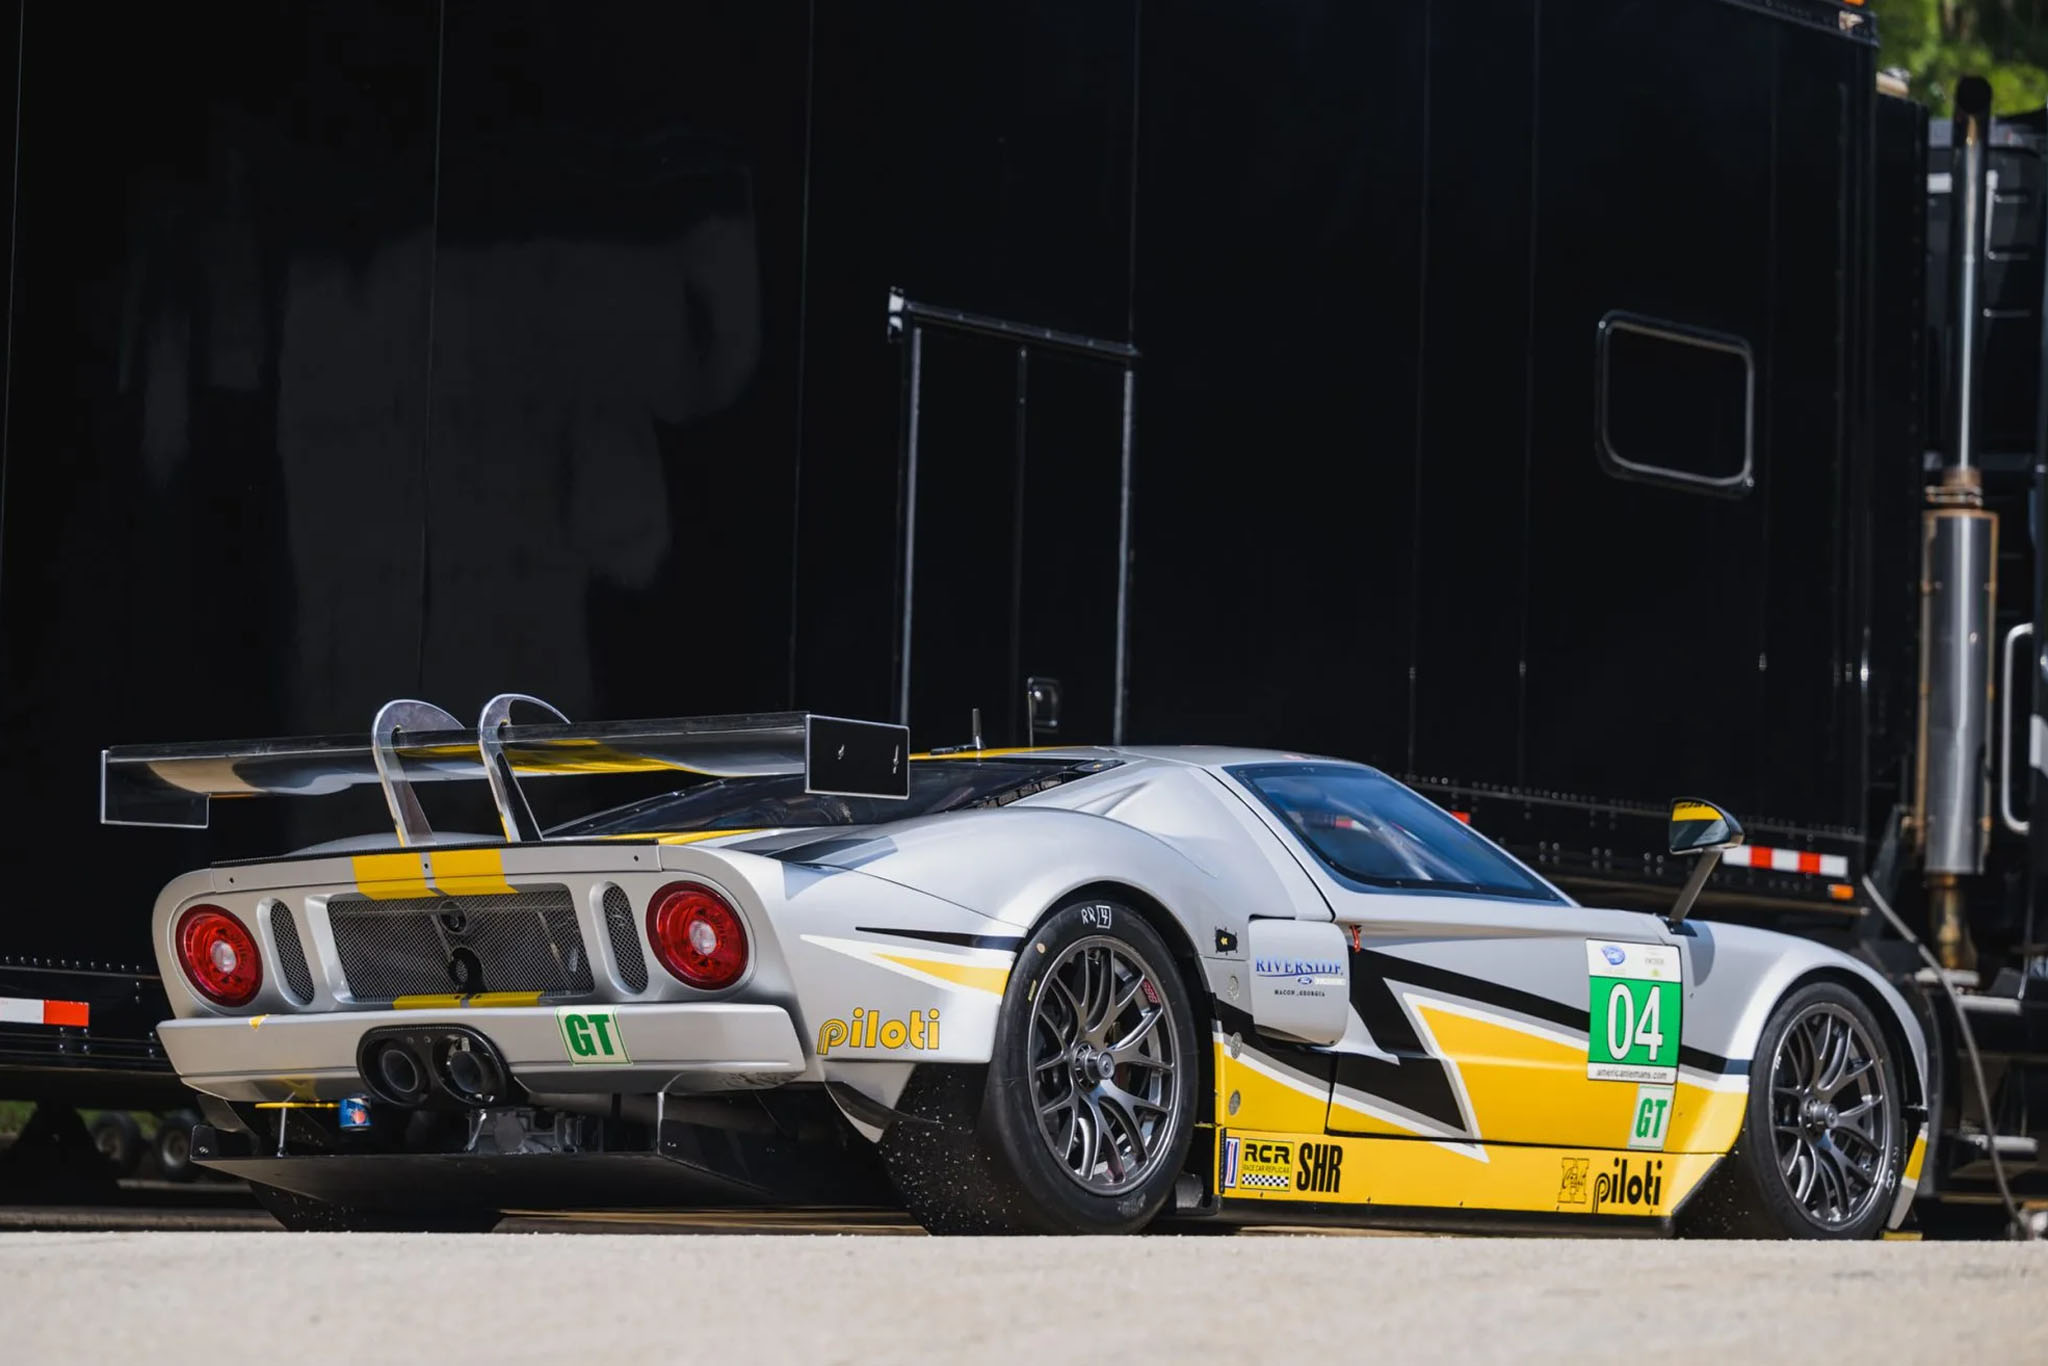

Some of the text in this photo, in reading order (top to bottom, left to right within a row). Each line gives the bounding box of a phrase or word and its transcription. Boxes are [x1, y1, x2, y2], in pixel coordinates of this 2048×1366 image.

[1256, 956, 1341, 975] RIVERSIDE
[564, 1013, 615, 1057] GT
[816, 1007, 940, 1055] piloti
[1607, 982, 1664, 1062] 04
[1597, 1069, 1668, 1080] americanlemans.com
[1635, 1098, 1668, 1138] GT
[1244, 1143, 1290, 1165] RCR
[1296, 1142, 1343, 1193] SHR
[1592, 1157, 1663, 1214] piloti
